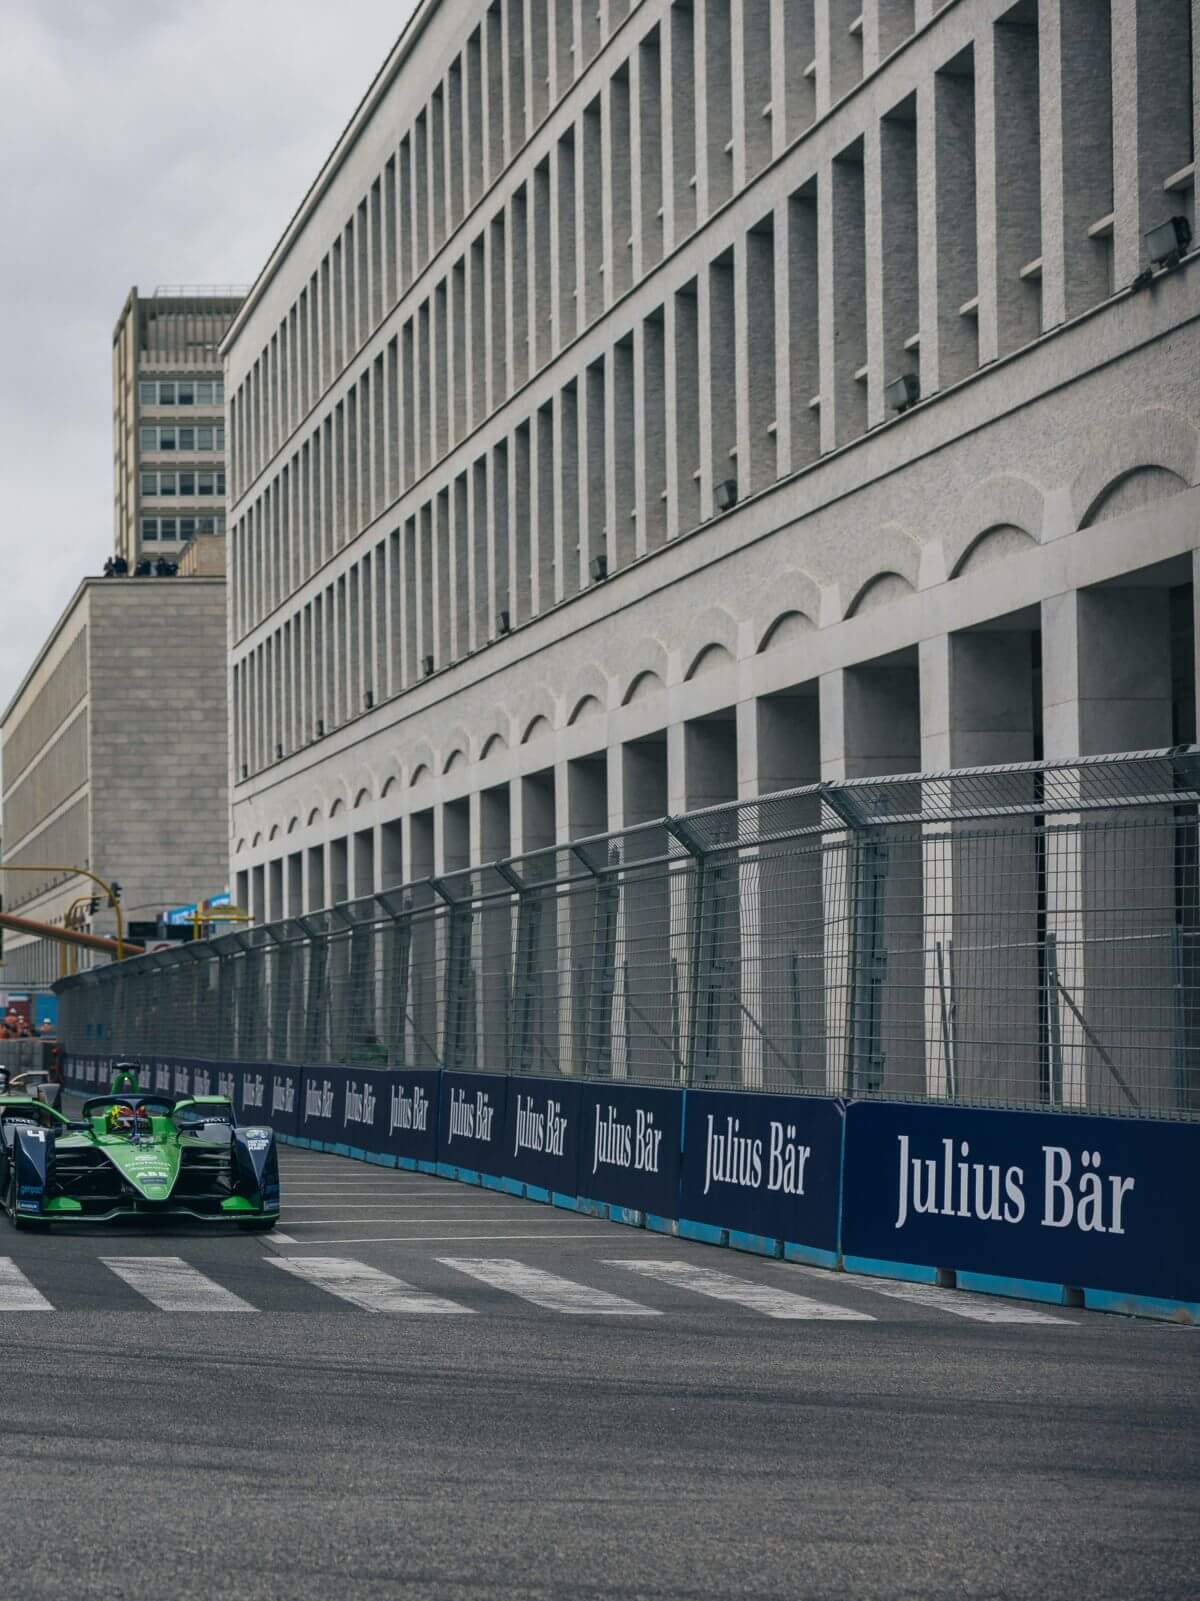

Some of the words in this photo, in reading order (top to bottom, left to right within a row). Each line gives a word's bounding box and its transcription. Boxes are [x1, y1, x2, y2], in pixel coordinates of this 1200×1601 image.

[343, 1080, 362, 1128] Julius
[389, 1085, 412, 1136] Julius
[412, 1086, 429, 1130] Bär
[448, 1088, 474, 1144] Julius
[475, 1091, 494, 1141] Bär
[514, 1094, 544, 1157] Julius
[545, 1100, 567, 1156] Bär
[27, 1130, 45, 1142] 4
[592, 1104, 631, 1175] Julius
[634, 1109, 662, 1172] Bär
[703, 1114, 762, 1195] Julius
[767, 1121, 811, 1195] Bär
[895, 1135, 1026, 1228] Julius
[1041, 1145, 1135, 1234] Bär
